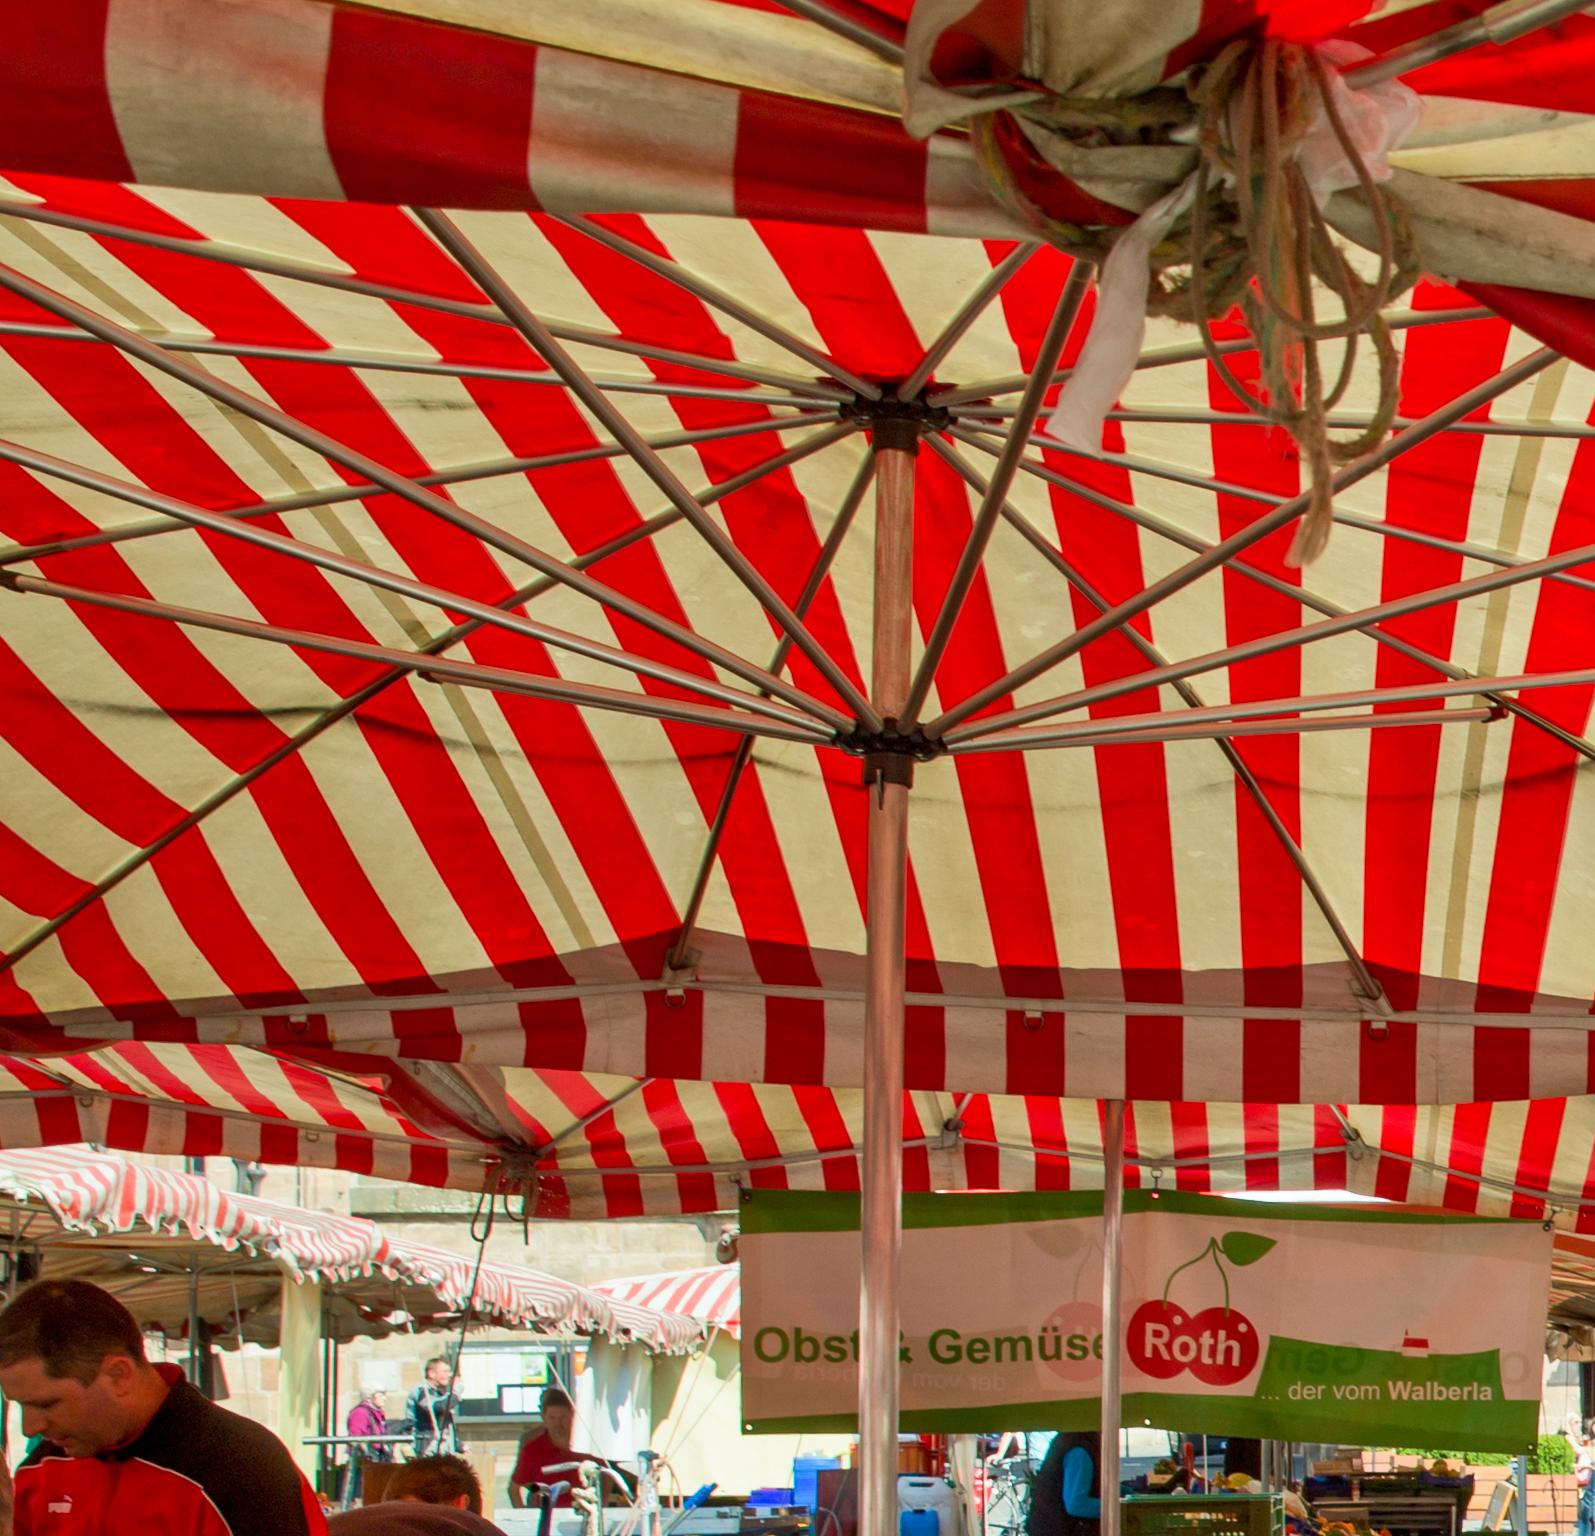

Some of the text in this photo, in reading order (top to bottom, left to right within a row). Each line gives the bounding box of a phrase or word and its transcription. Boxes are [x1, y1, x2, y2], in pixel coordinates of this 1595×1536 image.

[928, 1326, 1103, 1366] Gemüse
[1143, 1321, 1241, 1367] Roth
[1288, 1381, 1326, 1401] der
[1332, 1385, 1380, 1401] vom
[1387, 1380, 1492, 1401] Walberla
